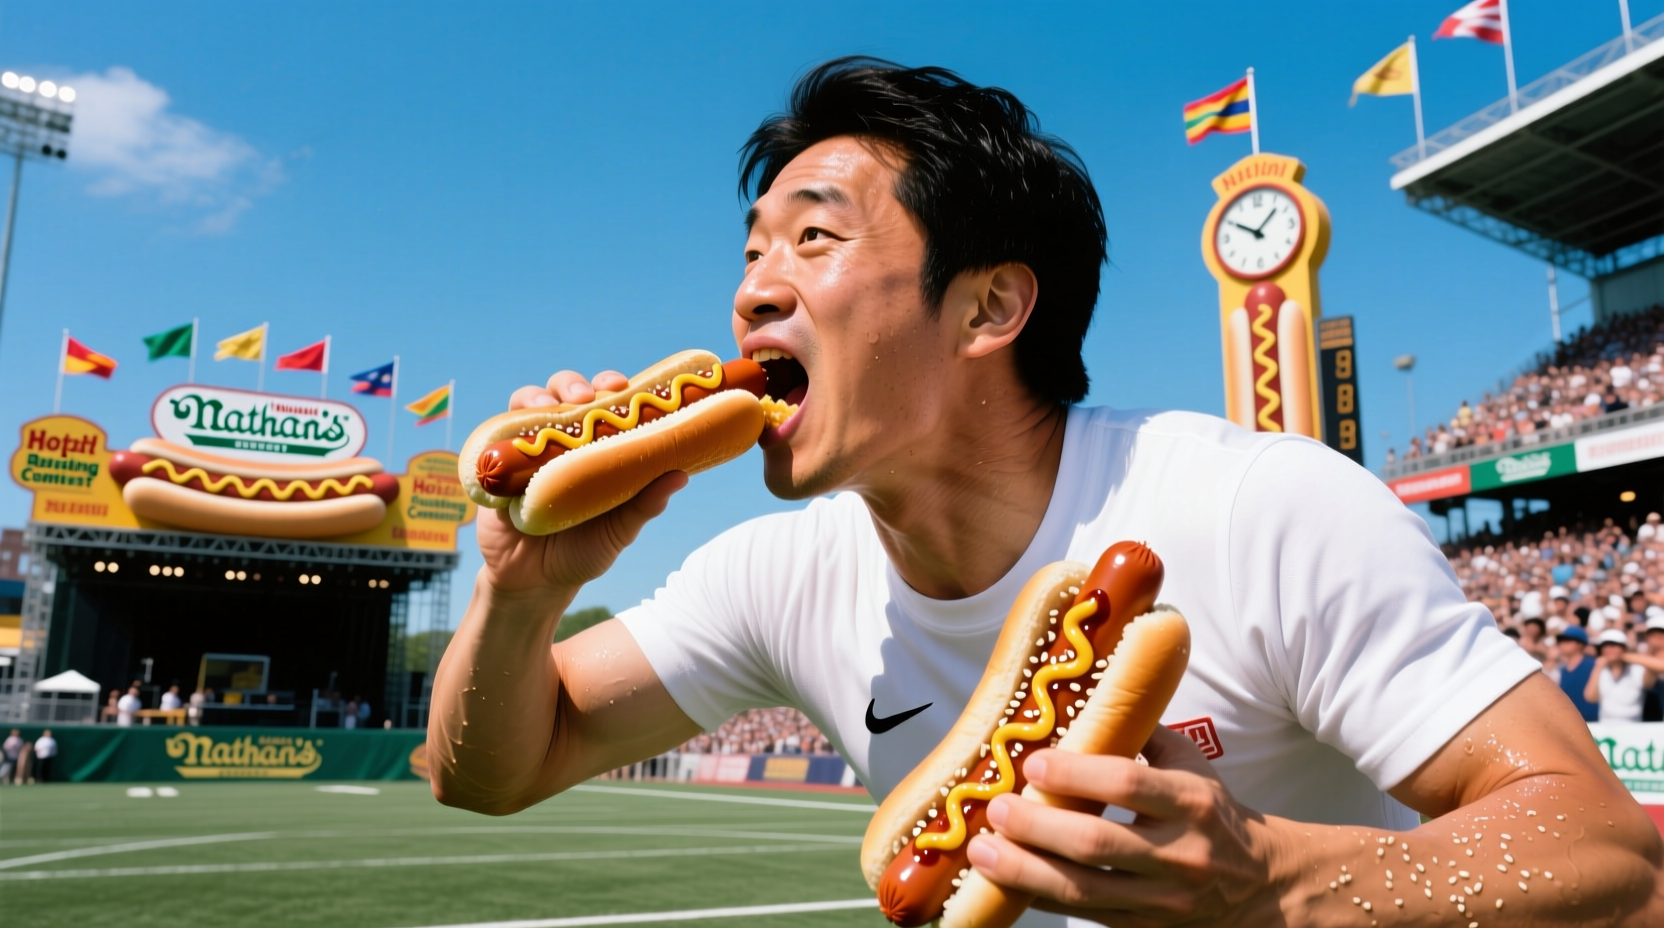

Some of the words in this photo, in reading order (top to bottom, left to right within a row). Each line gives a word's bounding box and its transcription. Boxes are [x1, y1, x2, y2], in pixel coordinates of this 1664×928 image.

[169, 394, 346, 442] Nathan's
[165, 731, 317, 766] Nathan's
[1593, 736, 1664, 773] Nat
